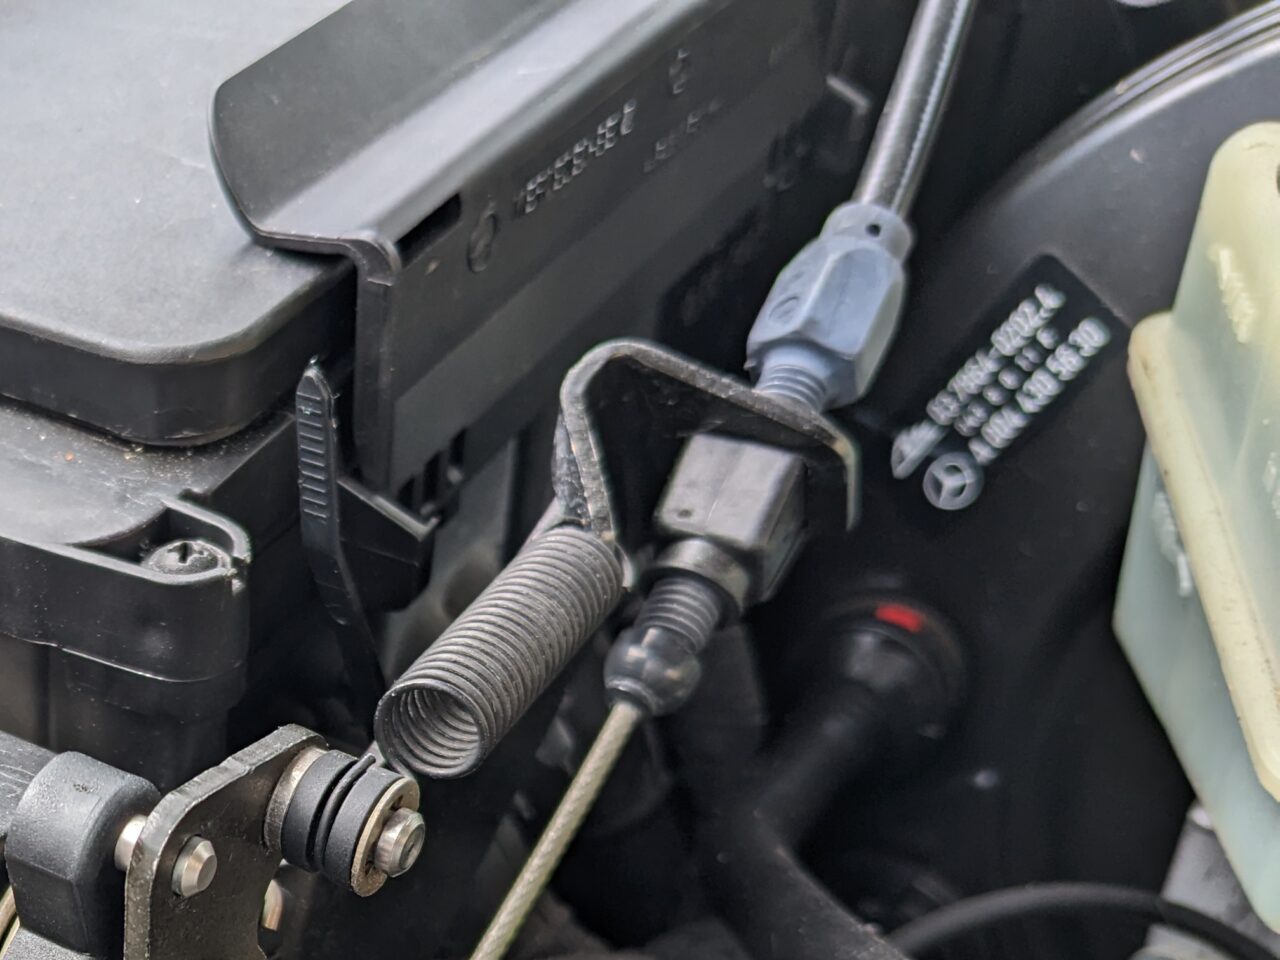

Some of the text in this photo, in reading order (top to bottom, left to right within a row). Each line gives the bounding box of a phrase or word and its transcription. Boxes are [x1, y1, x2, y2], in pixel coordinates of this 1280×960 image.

[1068, 316, 1110, 357] 30
[1016, 366, 1066, 413] 430
[981, 403, 1031, 448] 004
[969, 437, 1001, 465] A
